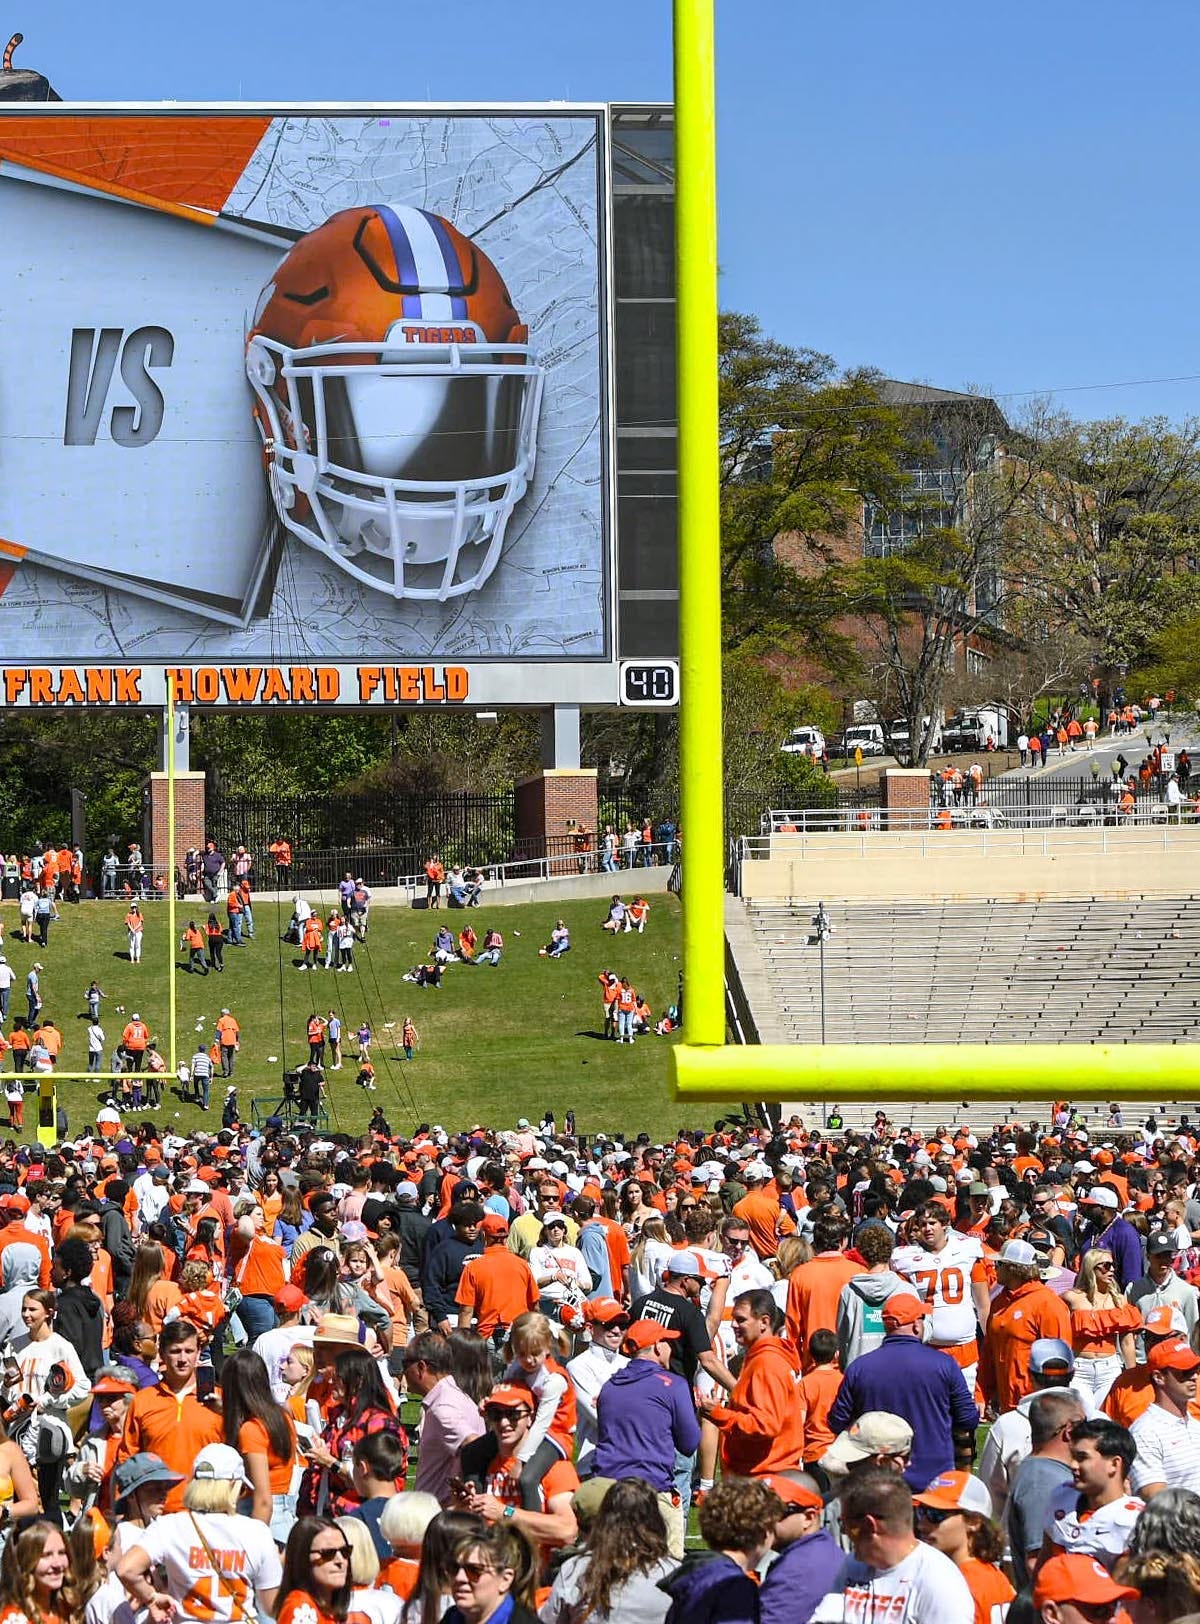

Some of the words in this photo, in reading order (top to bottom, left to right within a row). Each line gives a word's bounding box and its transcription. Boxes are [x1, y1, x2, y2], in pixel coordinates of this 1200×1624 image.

[402, 326, 477, 344] TIGERS
[63, 325, 175, 448] VS
[3, 667, 141, 702] FRANK
[168, 667, 340, 702] HOWARD
[357, 666, 470, 700] FIELD
[630, 668, 670, 698] 40
[621, 991, 632, 1003] 16
[916, 1267, 964, 1305] 70
